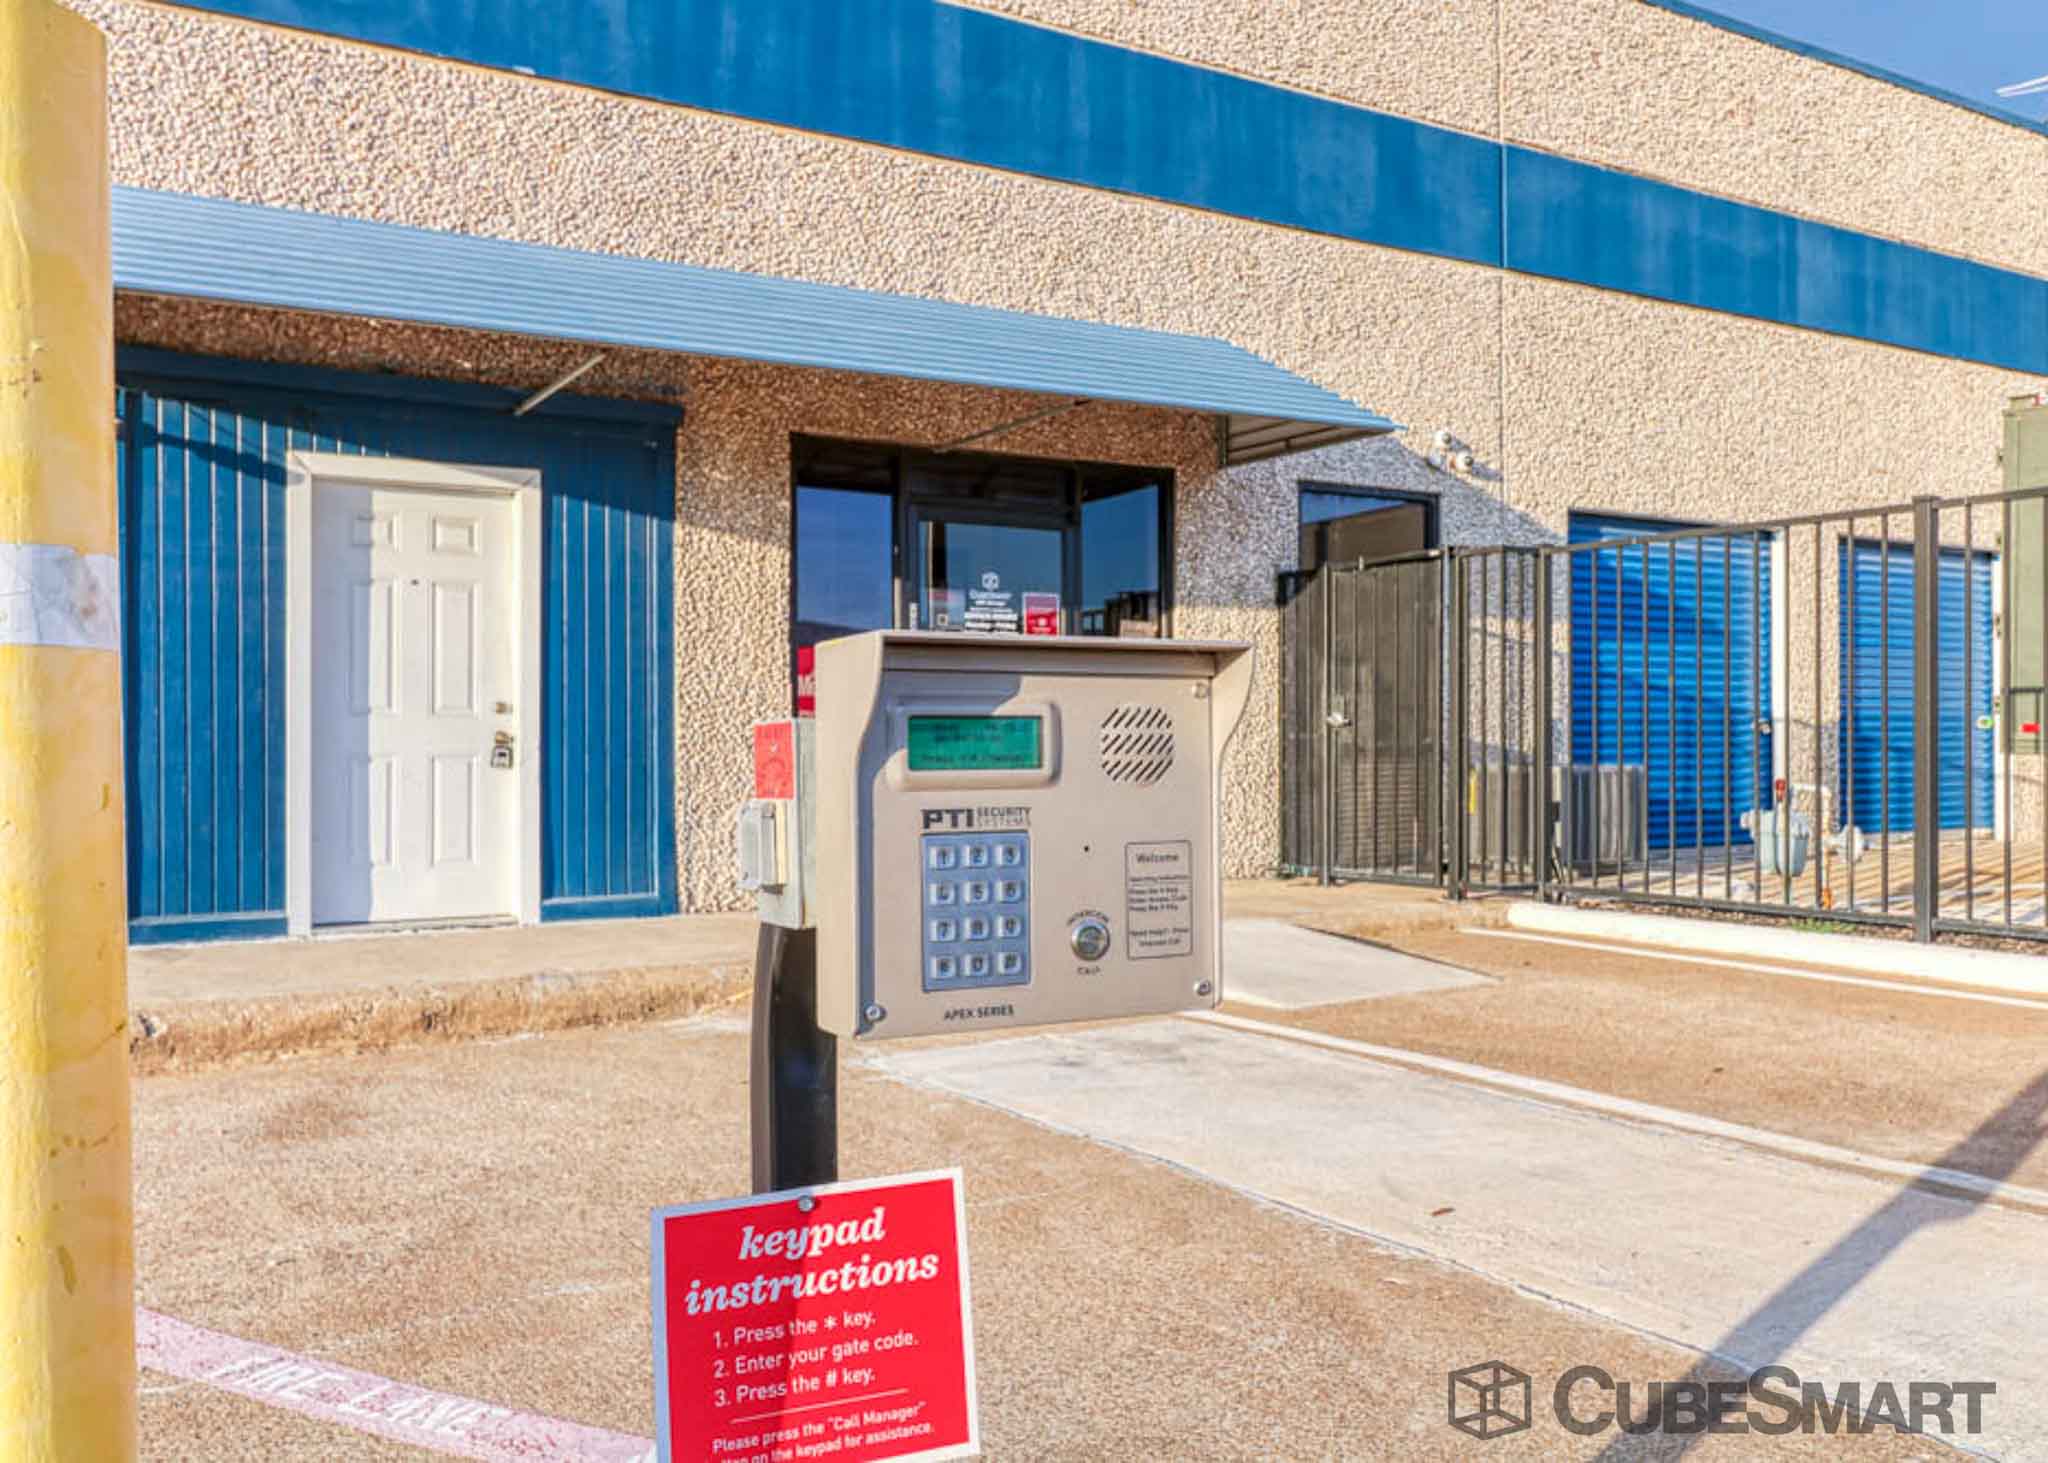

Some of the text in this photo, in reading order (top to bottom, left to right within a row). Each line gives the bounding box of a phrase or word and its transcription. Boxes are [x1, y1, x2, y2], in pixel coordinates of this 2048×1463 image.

[920, 806, 1032, 829] PTI SECURITY
[738, 1206, 886, 1261] keypad
[684, 1253, 939, 1316] instructions
[713, 1331, 729, 1349] 1.
[733, 1323, 785, 1346] Press
[789, 1318, 817, 1336] the
[843, 1311, 876, 1330] key.
[713, 1329, 919, 1379] 2. Enter your gate code.
[713, 1388, 730, 1408] 3.
[735, 1381, 788, 1403] Press
[791, 1374, 820, 1394] the
[842, 1367, 876, 1387] key.
[711, 1435, 760, 1456] Please
[762, 1427, 800, 1448] press
[802, 1422, 825, 1437] the
[770, 1447, 793, 1462] the
[795, 1436, 842, 1457] keypad
[845, 1432, 862, 1447] for
